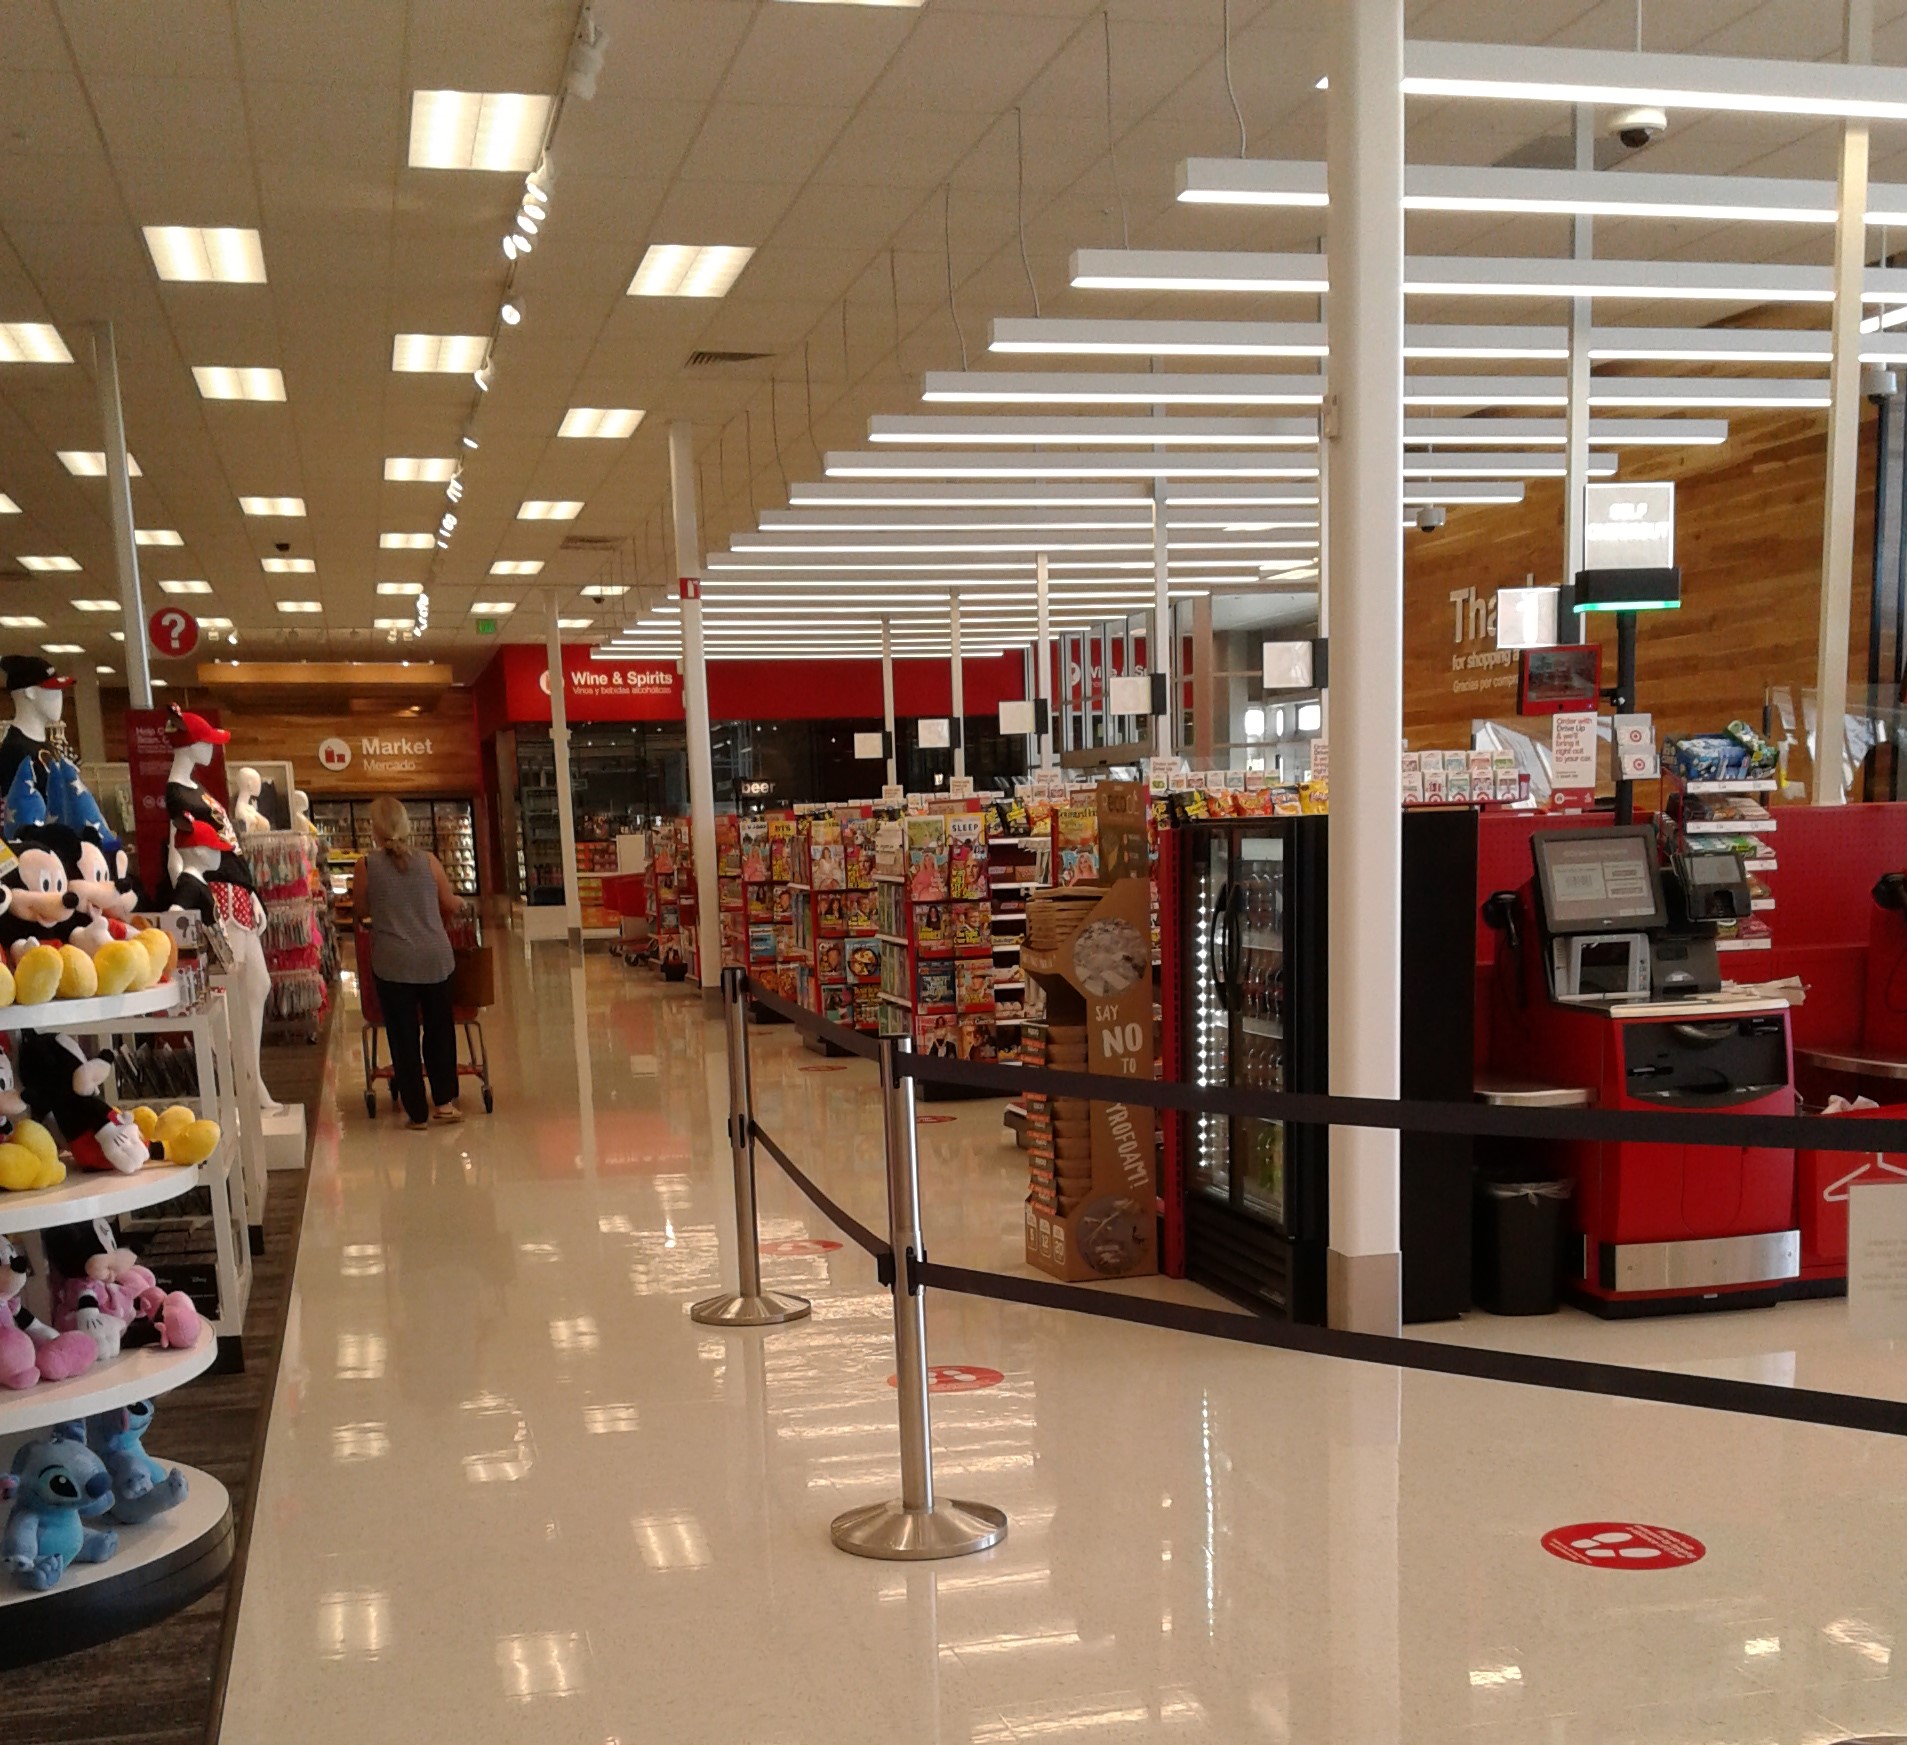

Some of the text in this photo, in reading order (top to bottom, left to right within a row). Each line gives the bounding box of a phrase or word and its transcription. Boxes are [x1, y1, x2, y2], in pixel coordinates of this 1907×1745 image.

[1452, 655, 1466, 671] for
[1467, 651, 1511, 670] shopping
[571, 671, 673, 687] Wine & Spirits
[1480, 678, 1492, 692] por
[573, 687, 594, 695] Vinos
[594, 688, 600, 696] y
[1556, 717, 1592, 725] Order with
[1575, 725, 1586, 733] Up
[361, 738, 432, 755] Market
[1556, 739, 1574, 748] bring
[1556, 747, 1584, 756] right out
[363, 759, 416, 771] Mercado
[741, 781, 776, 794] beer
[952, 823, 979, 832] SLEEP
[1095, 1004, 1119, 1021] SAY
[1102, 1022, 1143, 1058] NO
[1121, 1057, 1137, 1074] TO
[1106, 1102, 1149, 1189] YROFOAM!
